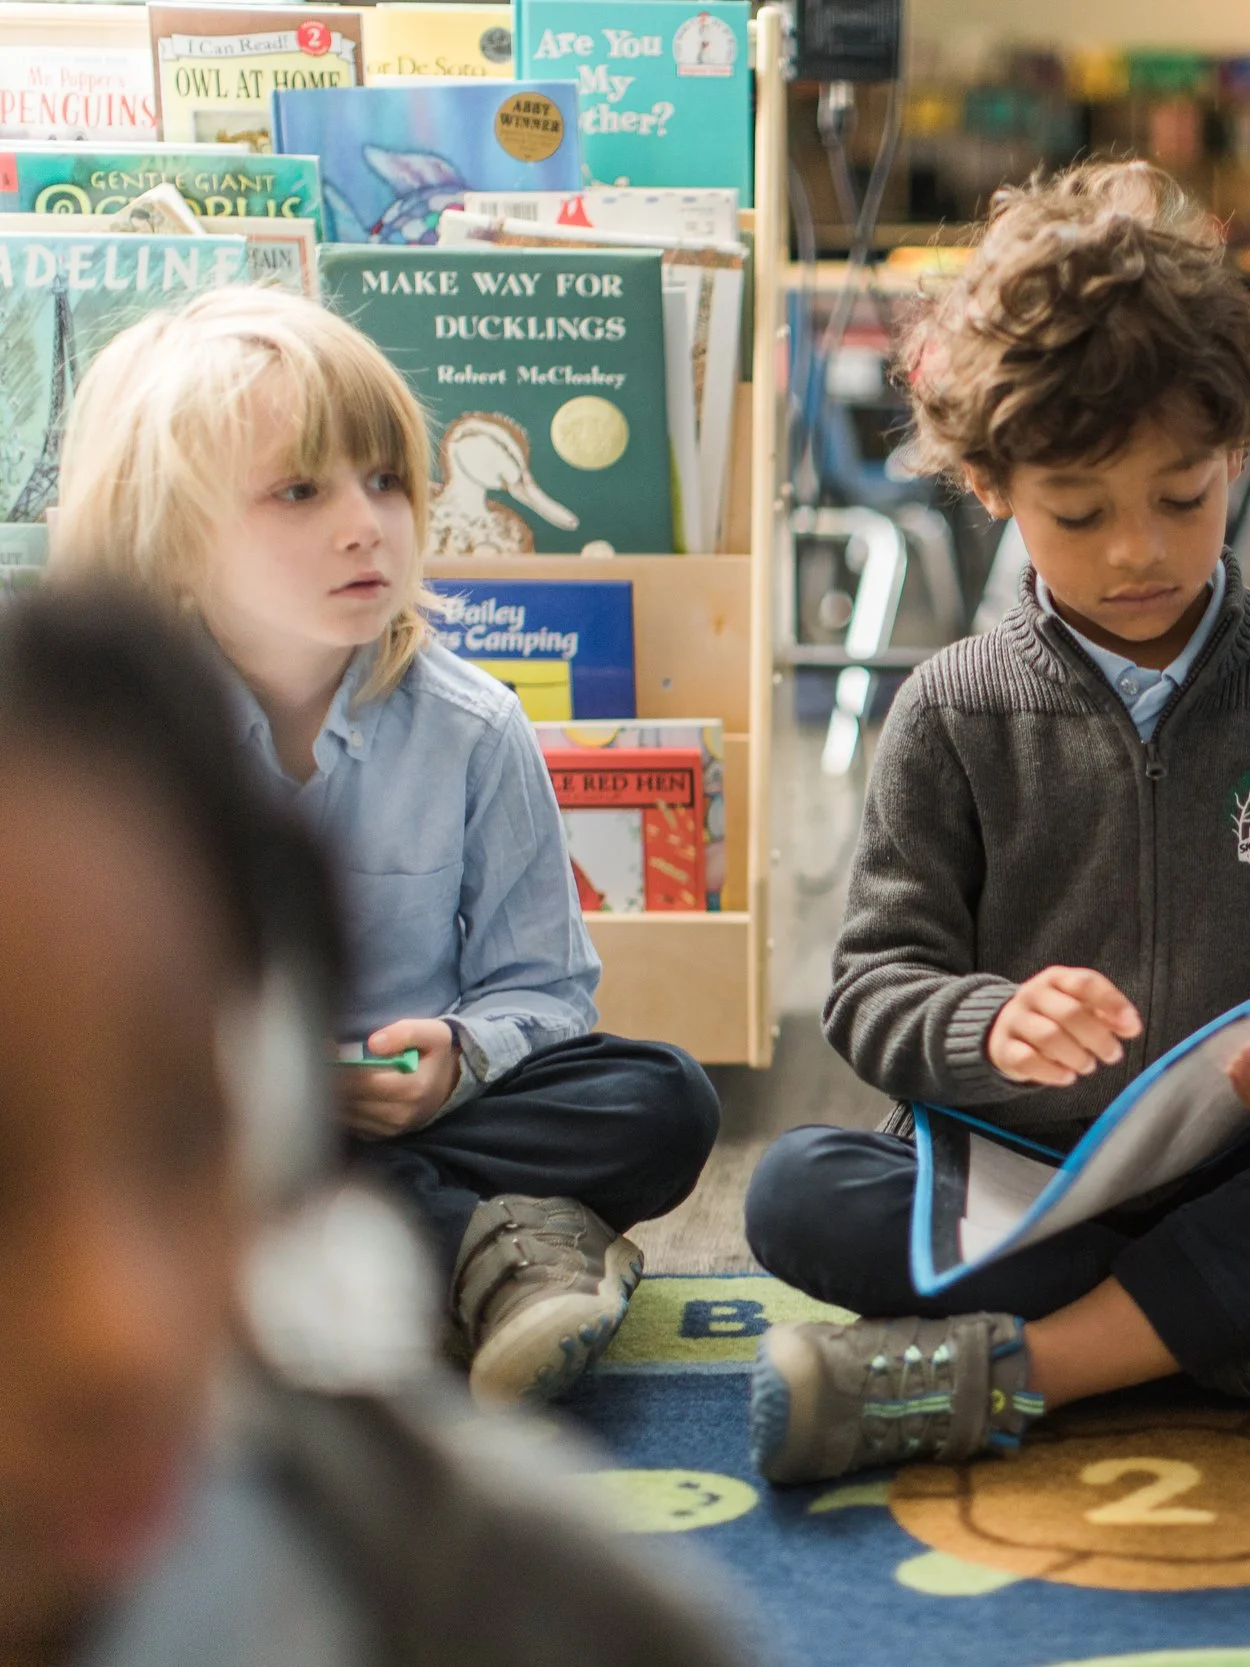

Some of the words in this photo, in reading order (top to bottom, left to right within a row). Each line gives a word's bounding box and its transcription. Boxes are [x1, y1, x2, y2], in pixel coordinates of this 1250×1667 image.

[199, 39, 234, 56] Can
[239, 34, 289, 53] Read!
[307, 28, 321, 47] 2
[532, 27, 595, 60] Are
[602, 28, 664, 59] You
[175, 67, 228, 98] OWL
[236, 69, 263, 99] AT
[272, 71, 341, 90] HOME
[576, 64, 637, 104] My
[0, 88, 159, 129] PENGUINS
[194, 173, 276, 193] GIANT
[362, 270, 458, 296] MAKE
[472, 272, 541, 297] WAY
[556, 273, 624, 298] FOR
[434, 315, 627, 341] DUCKLINGS
[437, 364, 506, 385] Robert
[516, 365, 627, 390] McCloskey
[464, 624, 579, 659] Camping
[583, 775, 628, 792] RED
[636, 775, 686, 792] HEN
[678, 1299, 772, 1338] B
[1080, 1457, 1216, 1526] 2
